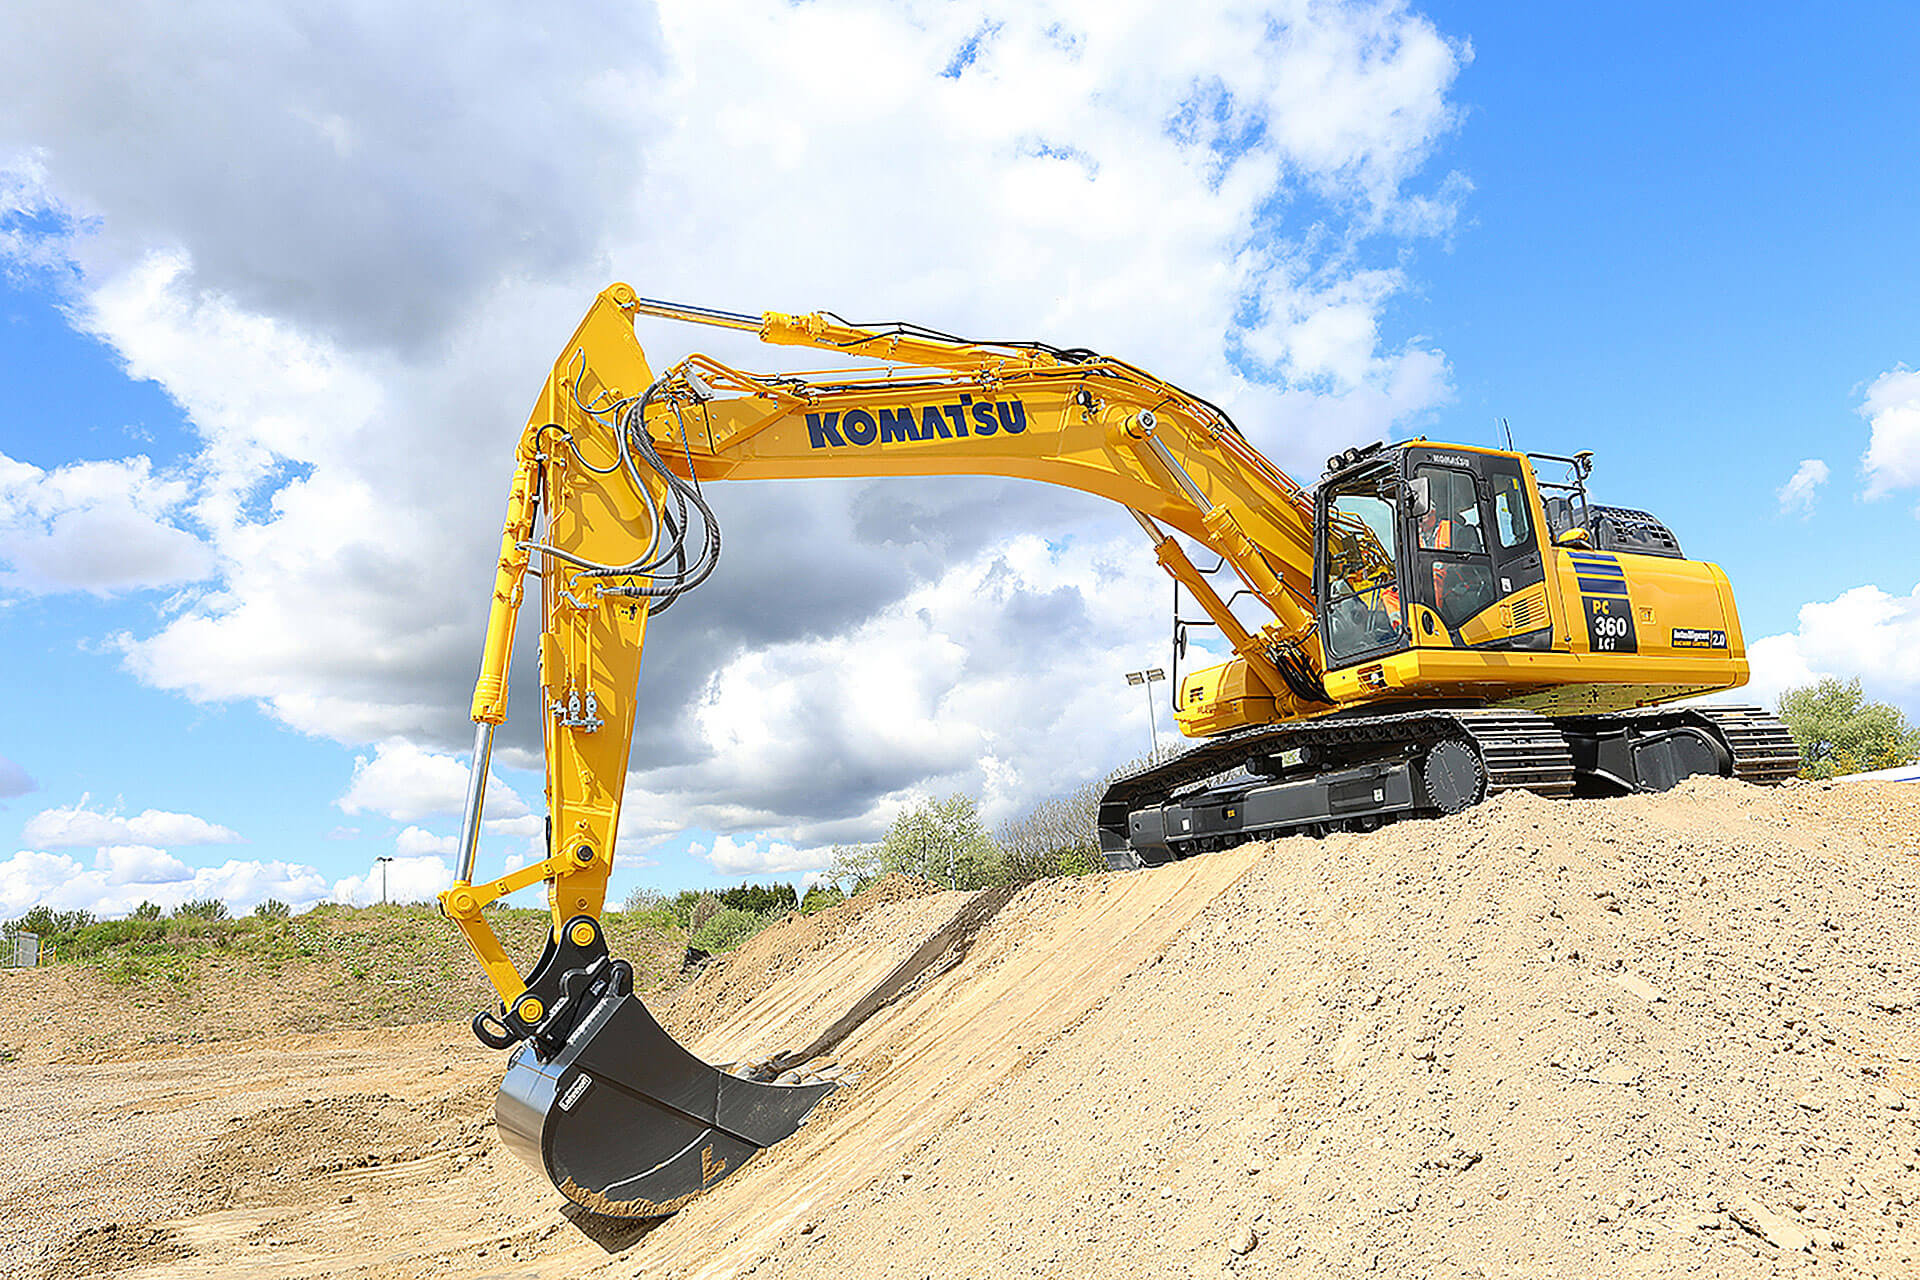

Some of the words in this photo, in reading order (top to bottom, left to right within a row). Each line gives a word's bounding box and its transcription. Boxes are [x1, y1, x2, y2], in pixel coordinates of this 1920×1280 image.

[805, 394, 1027, 448] KOMATSU
[1592, 600, 1610, 615] PC
[1595, 616, 1627, 637] 360
